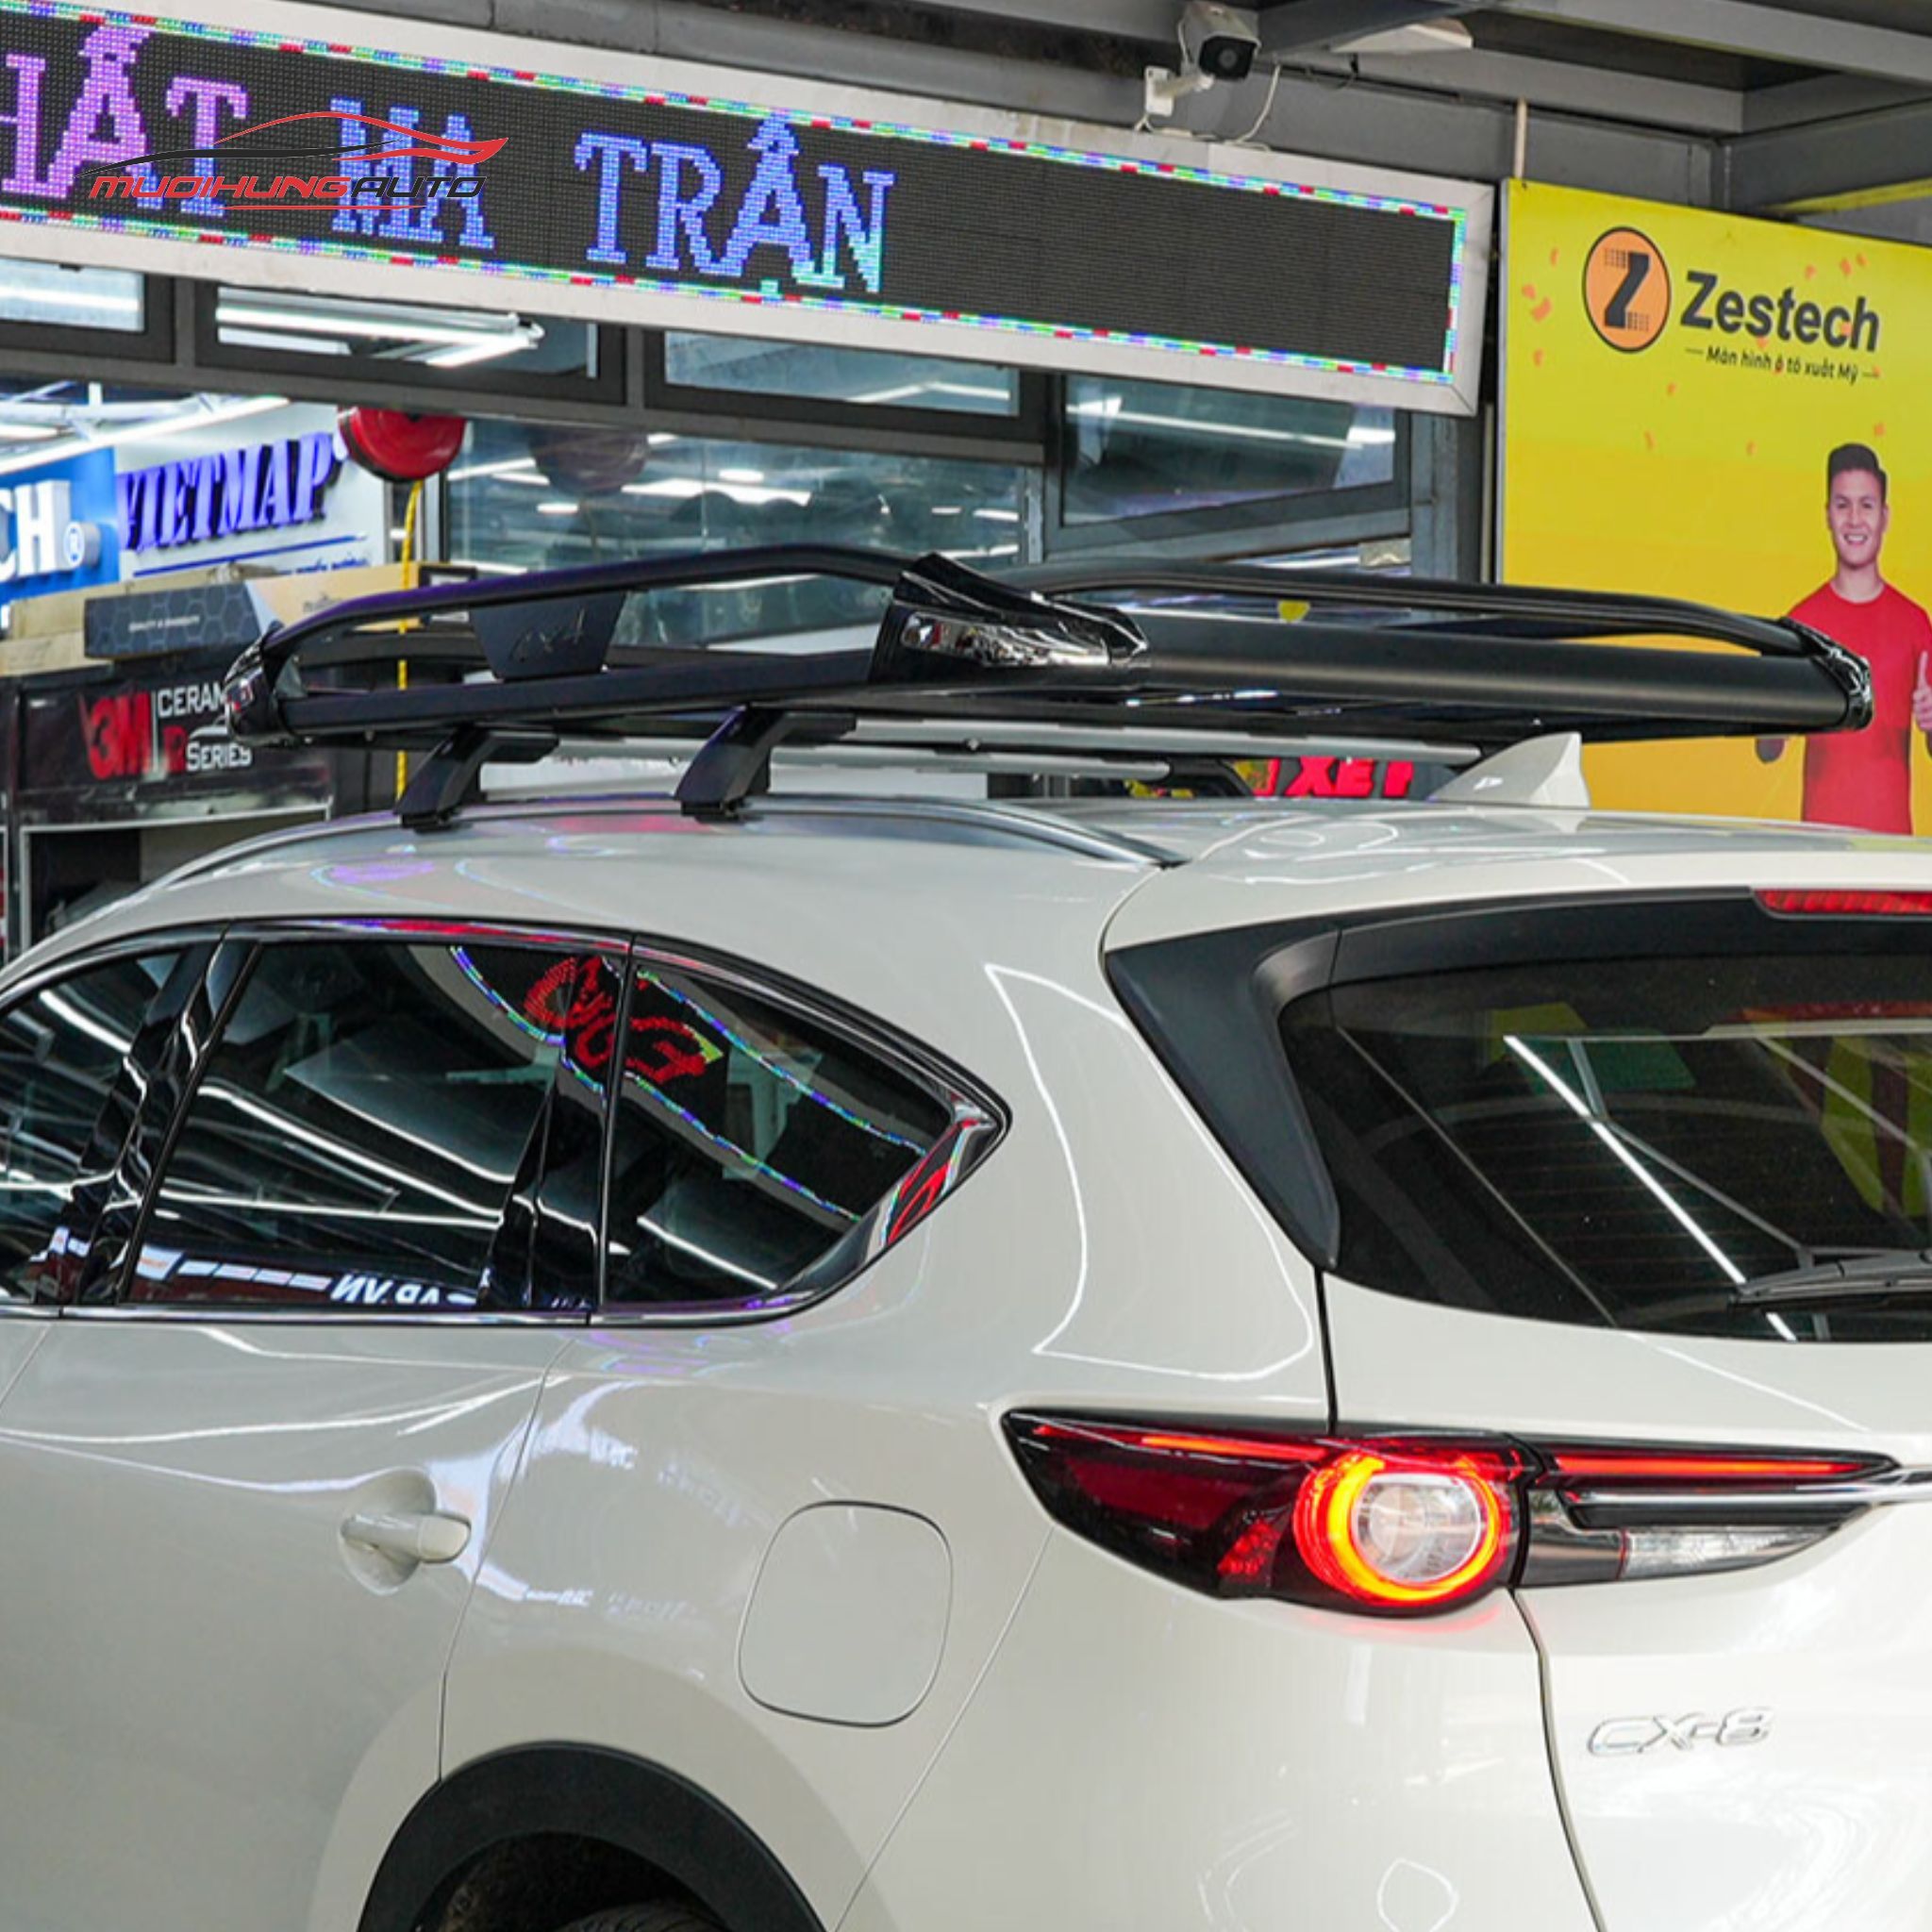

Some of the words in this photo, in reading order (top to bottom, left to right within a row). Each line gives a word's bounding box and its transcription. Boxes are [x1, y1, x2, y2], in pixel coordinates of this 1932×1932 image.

[574, 108, 895, 298] TRẬN
[1680, 269, 1880, 353] Zestech
[118, 431, 333, 554] VIETMAP
[90, 690, 152, 781] 3M
[1586, 1706, 1774, 1757] CX-8
